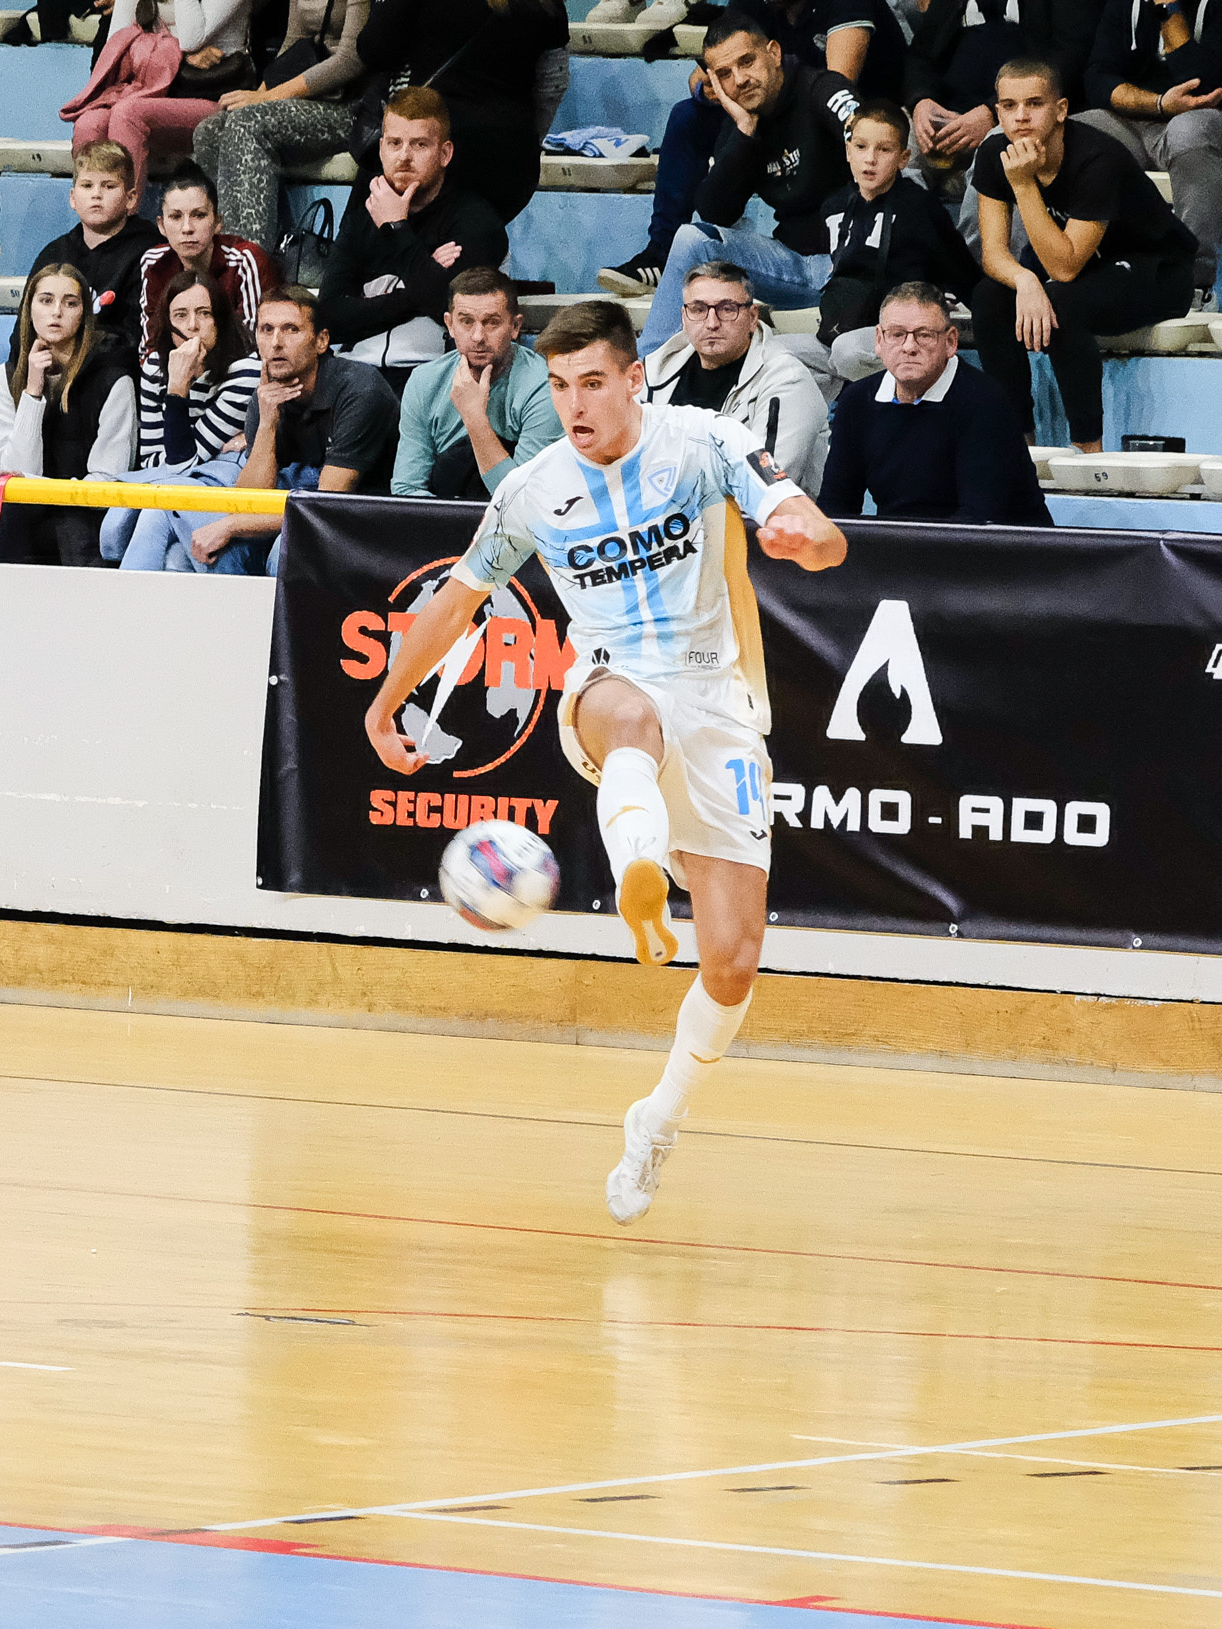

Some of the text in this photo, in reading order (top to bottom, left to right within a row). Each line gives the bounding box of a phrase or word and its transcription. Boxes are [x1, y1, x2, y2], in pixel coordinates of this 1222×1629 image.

[567, 512, 690, 570] COMO
[573, 539, 698, 590] TEMPERA
[688, 651, 720, 664] FOUR
[368, 788, 559, 835] SECURITY
[958, 794, 1111, 848] ADO
